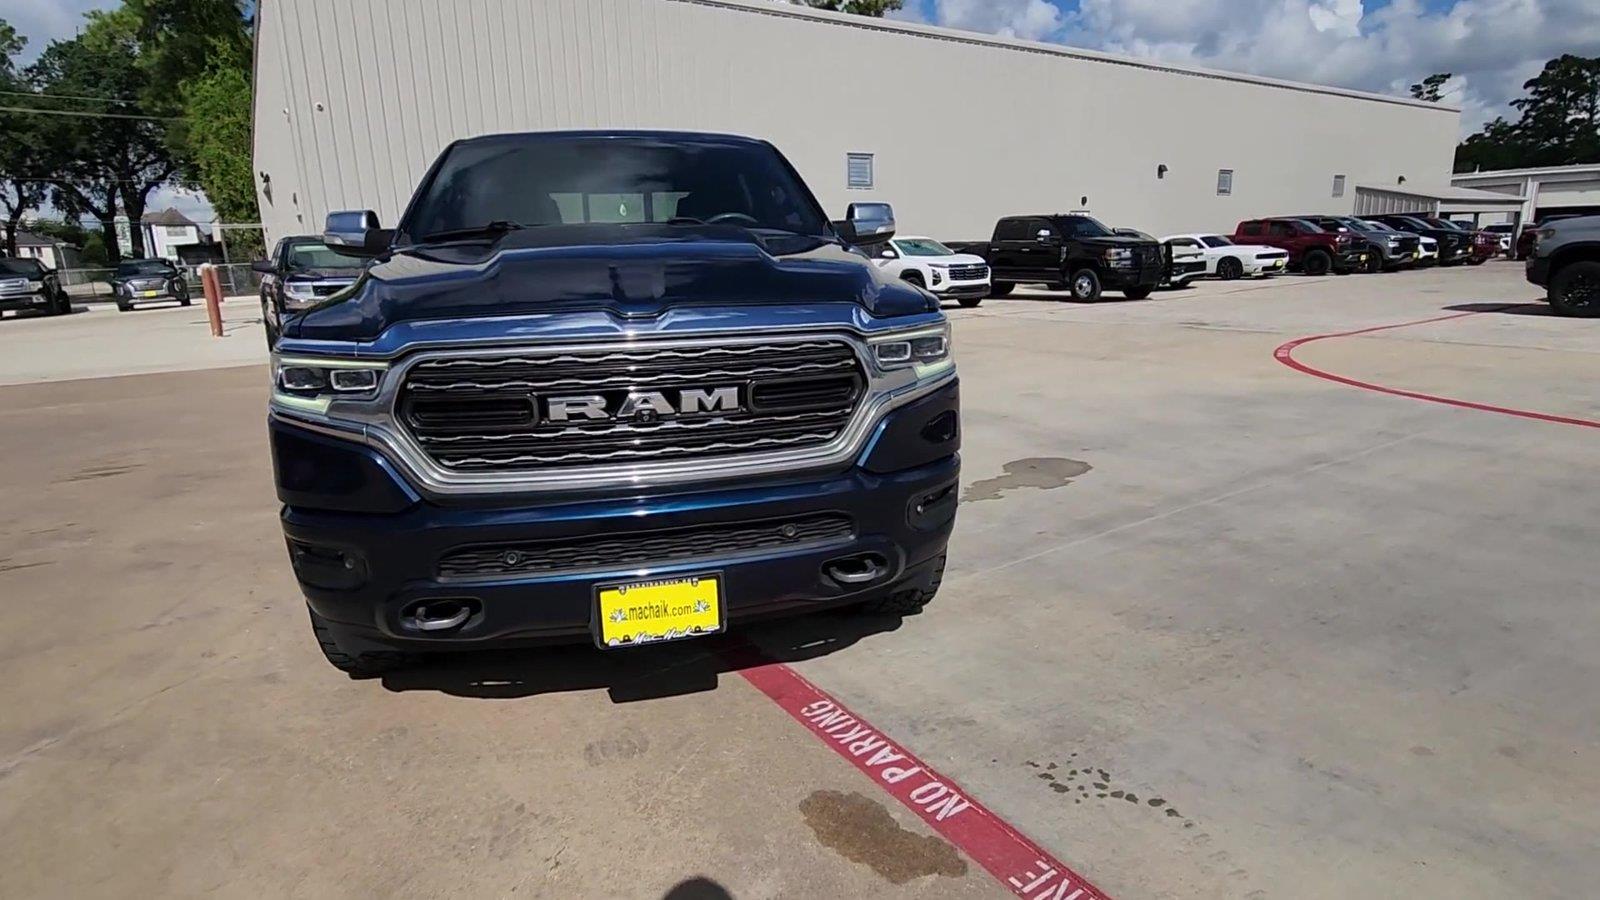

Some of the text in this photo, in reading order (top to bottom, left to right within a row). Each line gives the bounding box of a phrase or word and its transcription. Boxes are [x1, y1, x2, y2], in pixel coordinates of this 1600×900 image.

[547, 387, 739, 420] RAM
[628, 600, 692, 621] machaik.com
[800, 700, 921, 785] PARKING
[909, 780, 971, 821] NO
